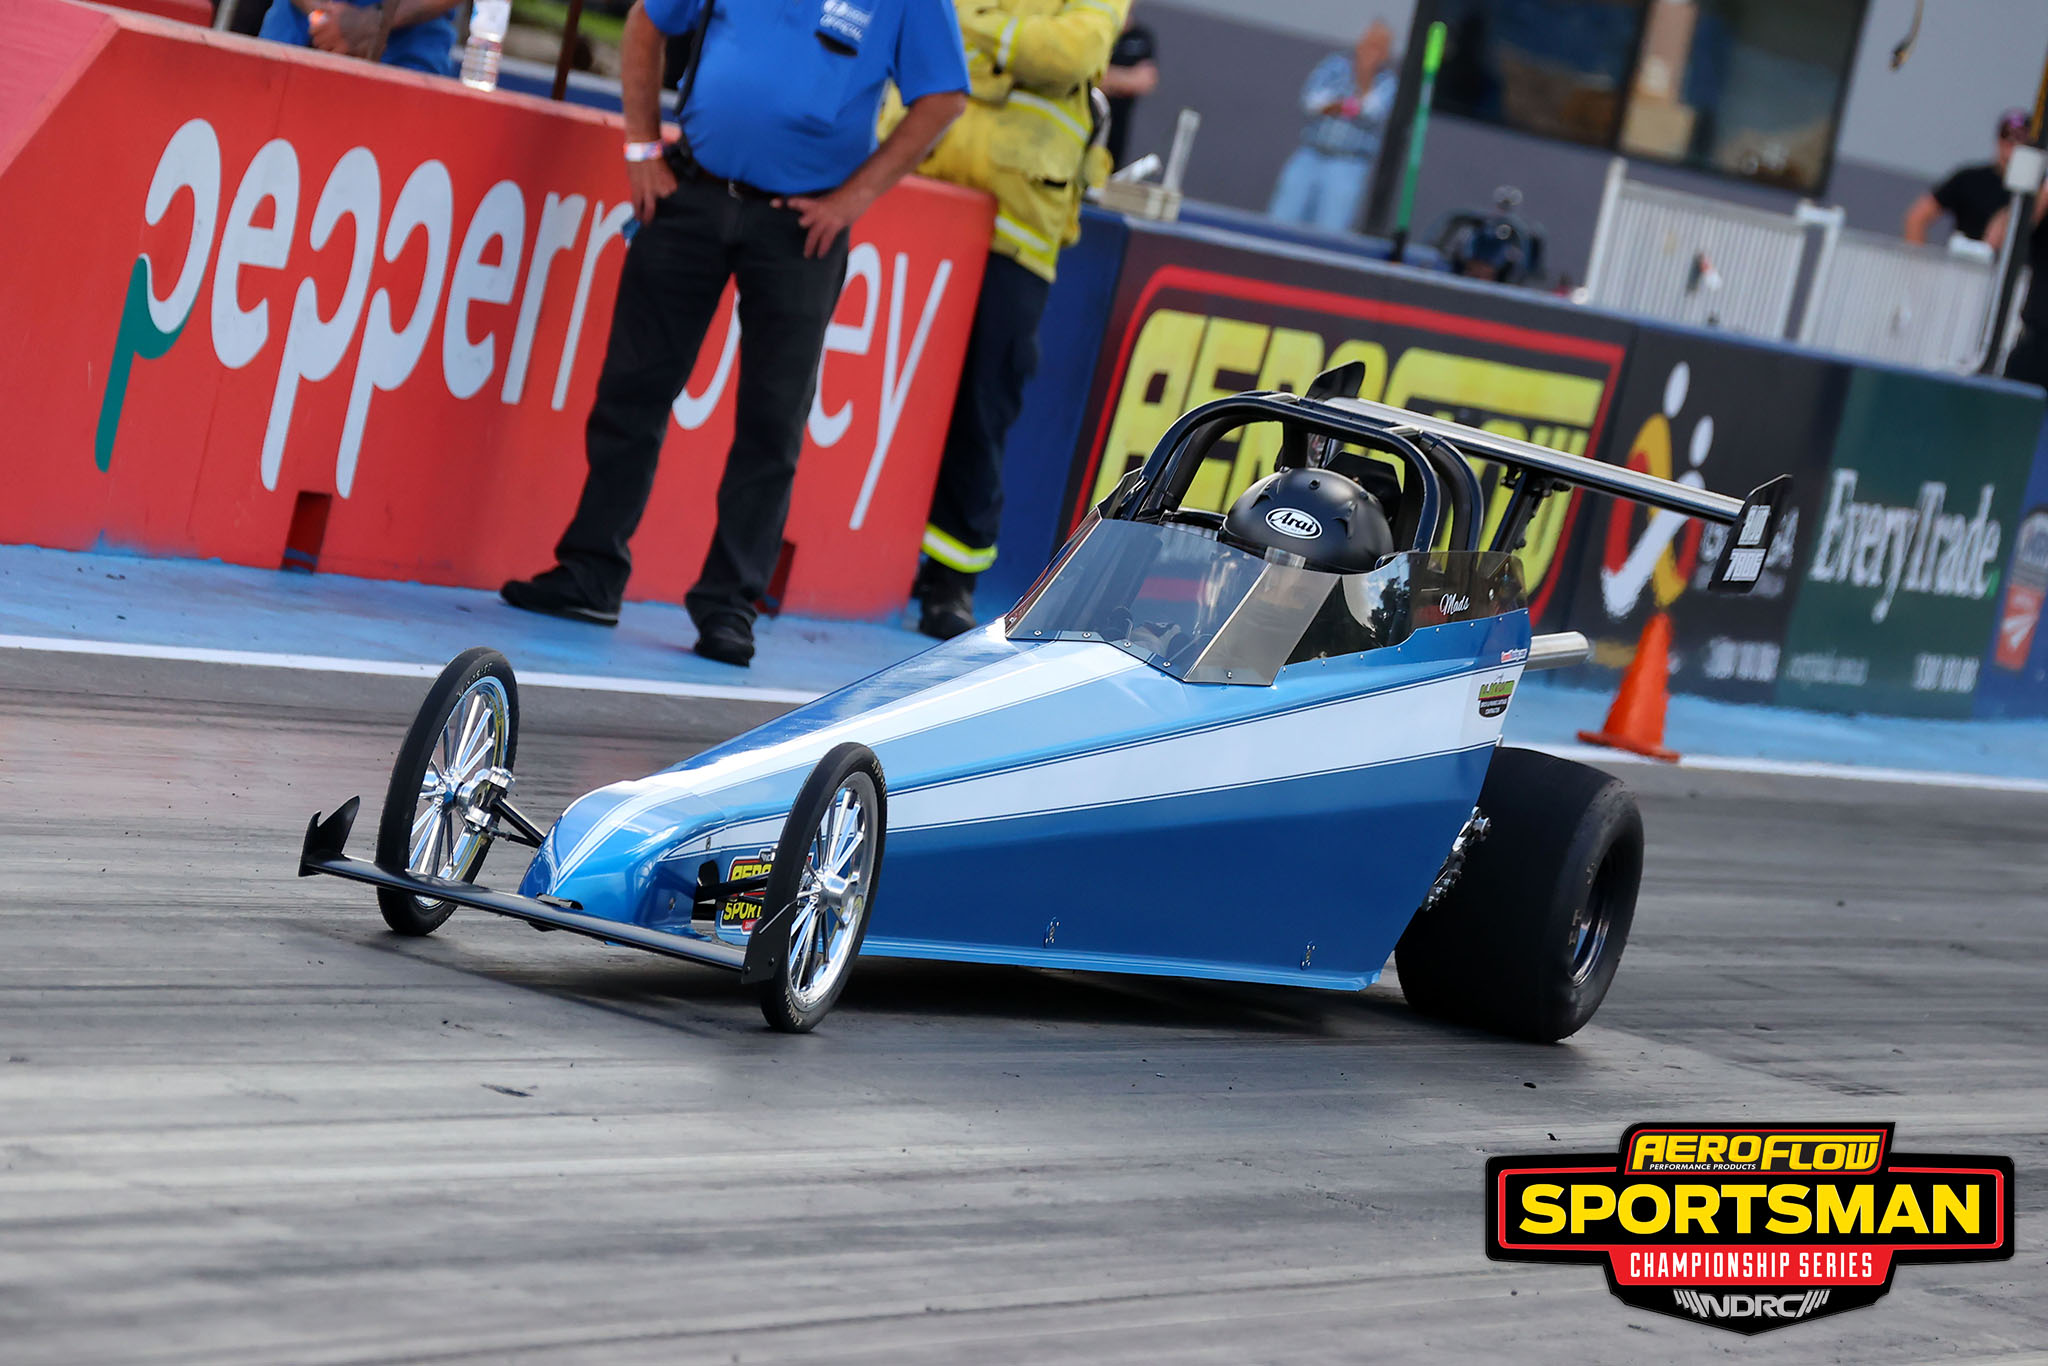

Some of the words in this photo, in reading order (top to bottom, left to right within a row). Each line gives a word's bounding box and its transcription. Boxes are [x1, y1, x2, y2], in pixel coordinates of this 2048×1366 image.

[95, 118, 952, 531] pepperey
[1270, 511, 1316, 532] Arai
[1440, 593, 1471, 616] Mads
